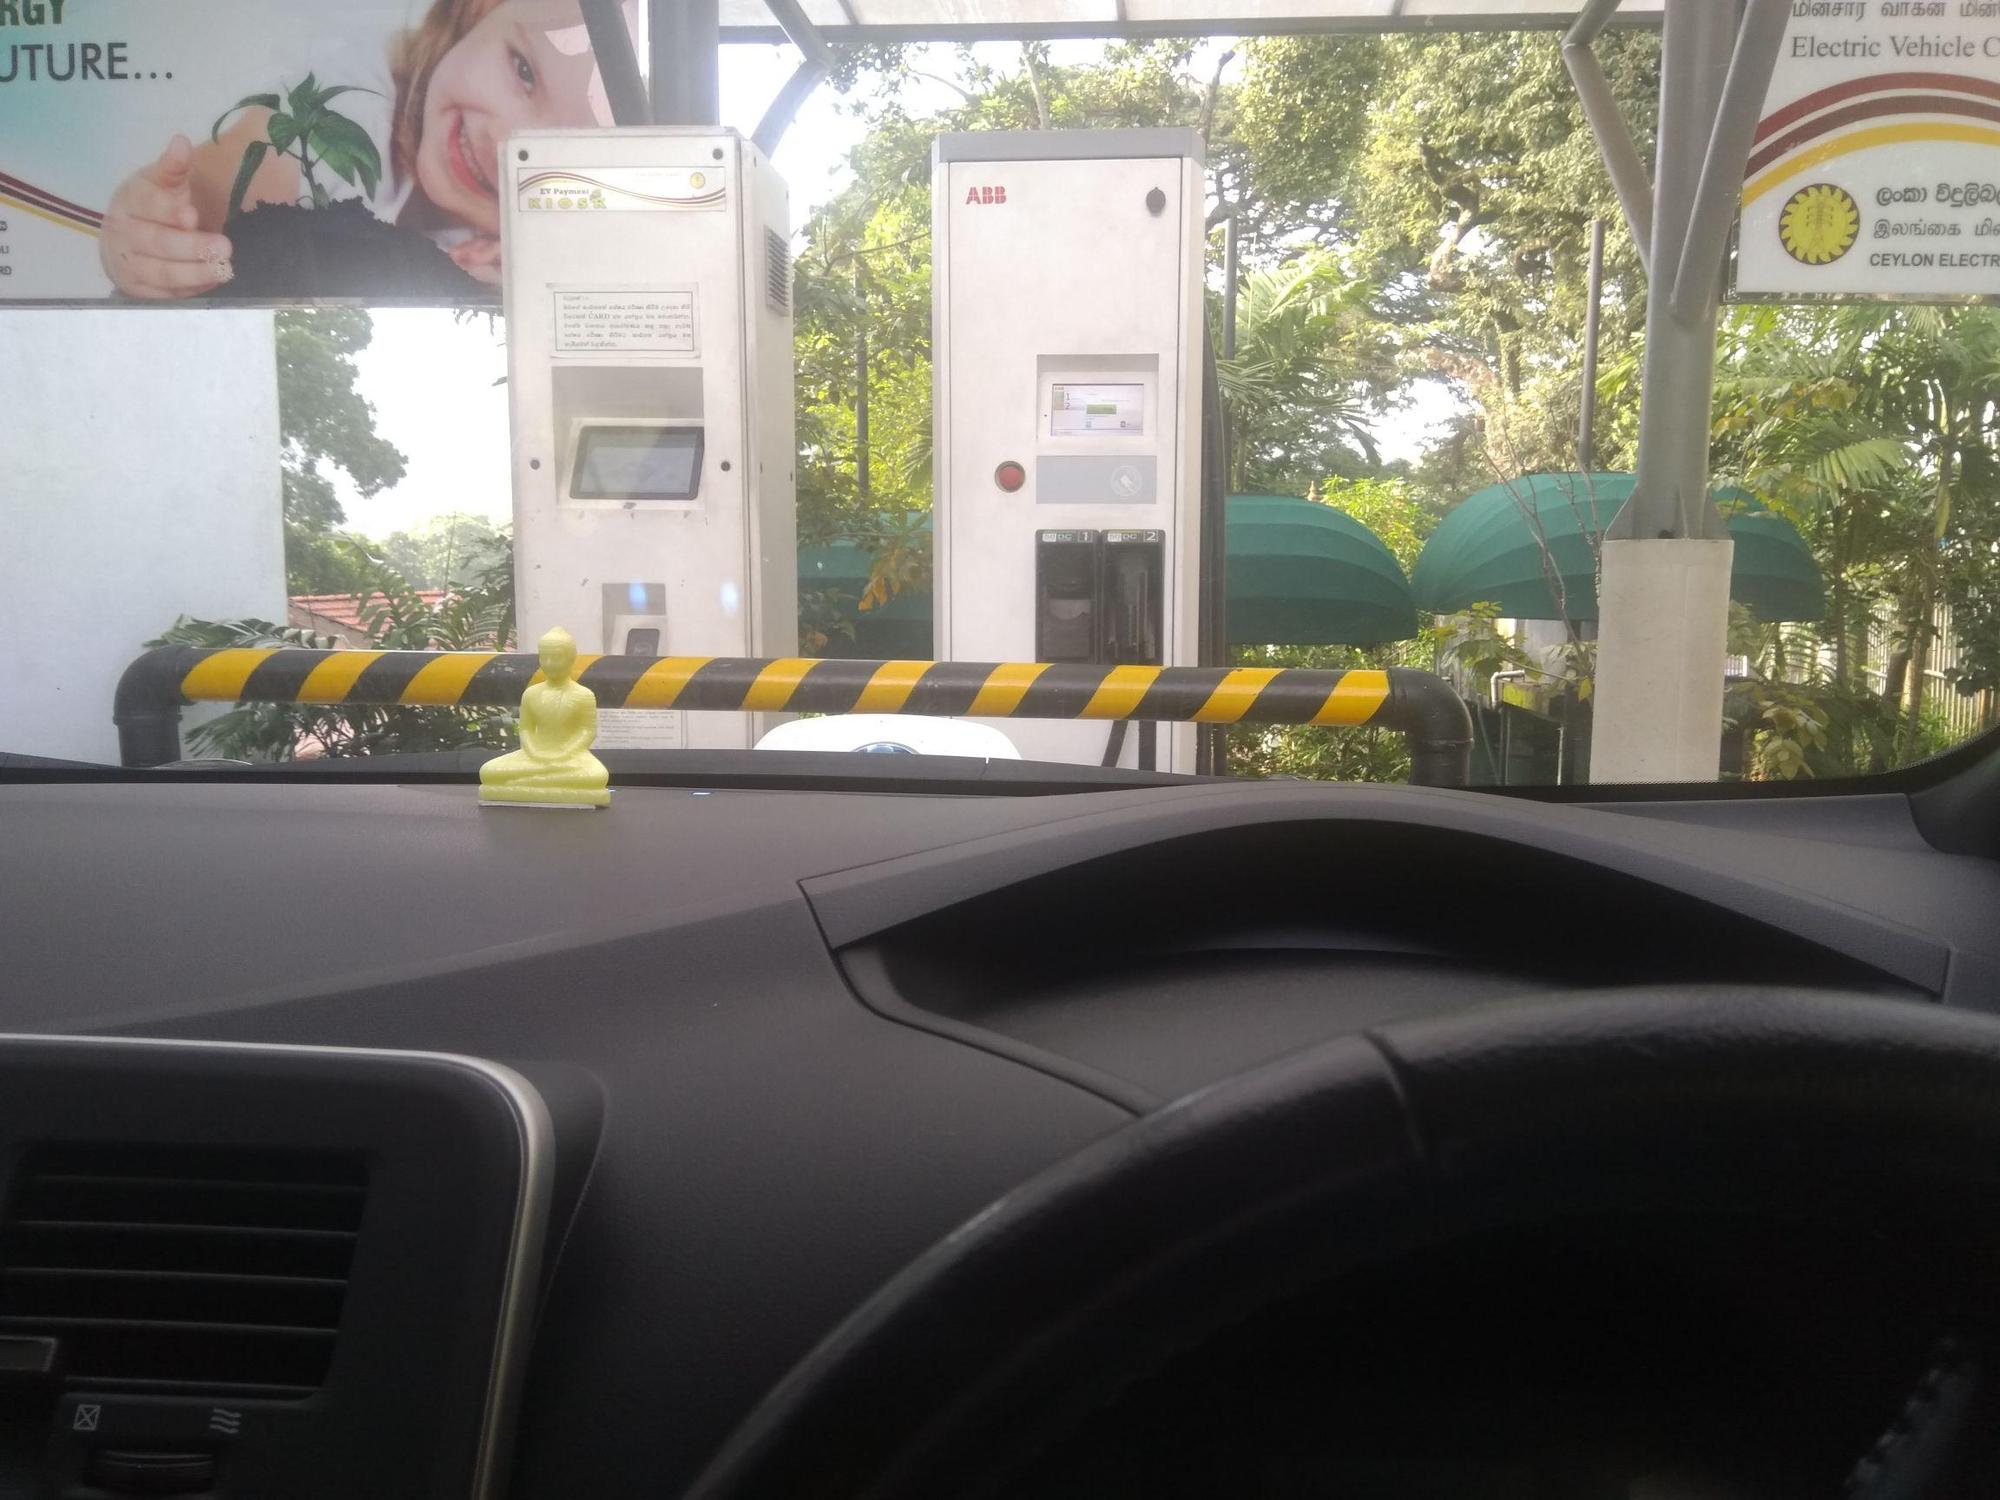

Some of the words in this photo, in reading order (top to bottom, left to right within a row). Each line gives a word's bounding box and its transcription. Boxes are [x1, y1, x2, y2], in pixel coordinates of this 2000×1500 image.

[1791, 36, 1881, 58] Electric
[1890, 36, 1976, 58] Vehicle
[553, 188, 589, 196] Payment
[965, 186, 1007, 205] ABB
[528, 197, 607, 209] KIOSK
[1869, 253, 1934, 267] CEYLON
[1146, 531, 1156, 541] 2
